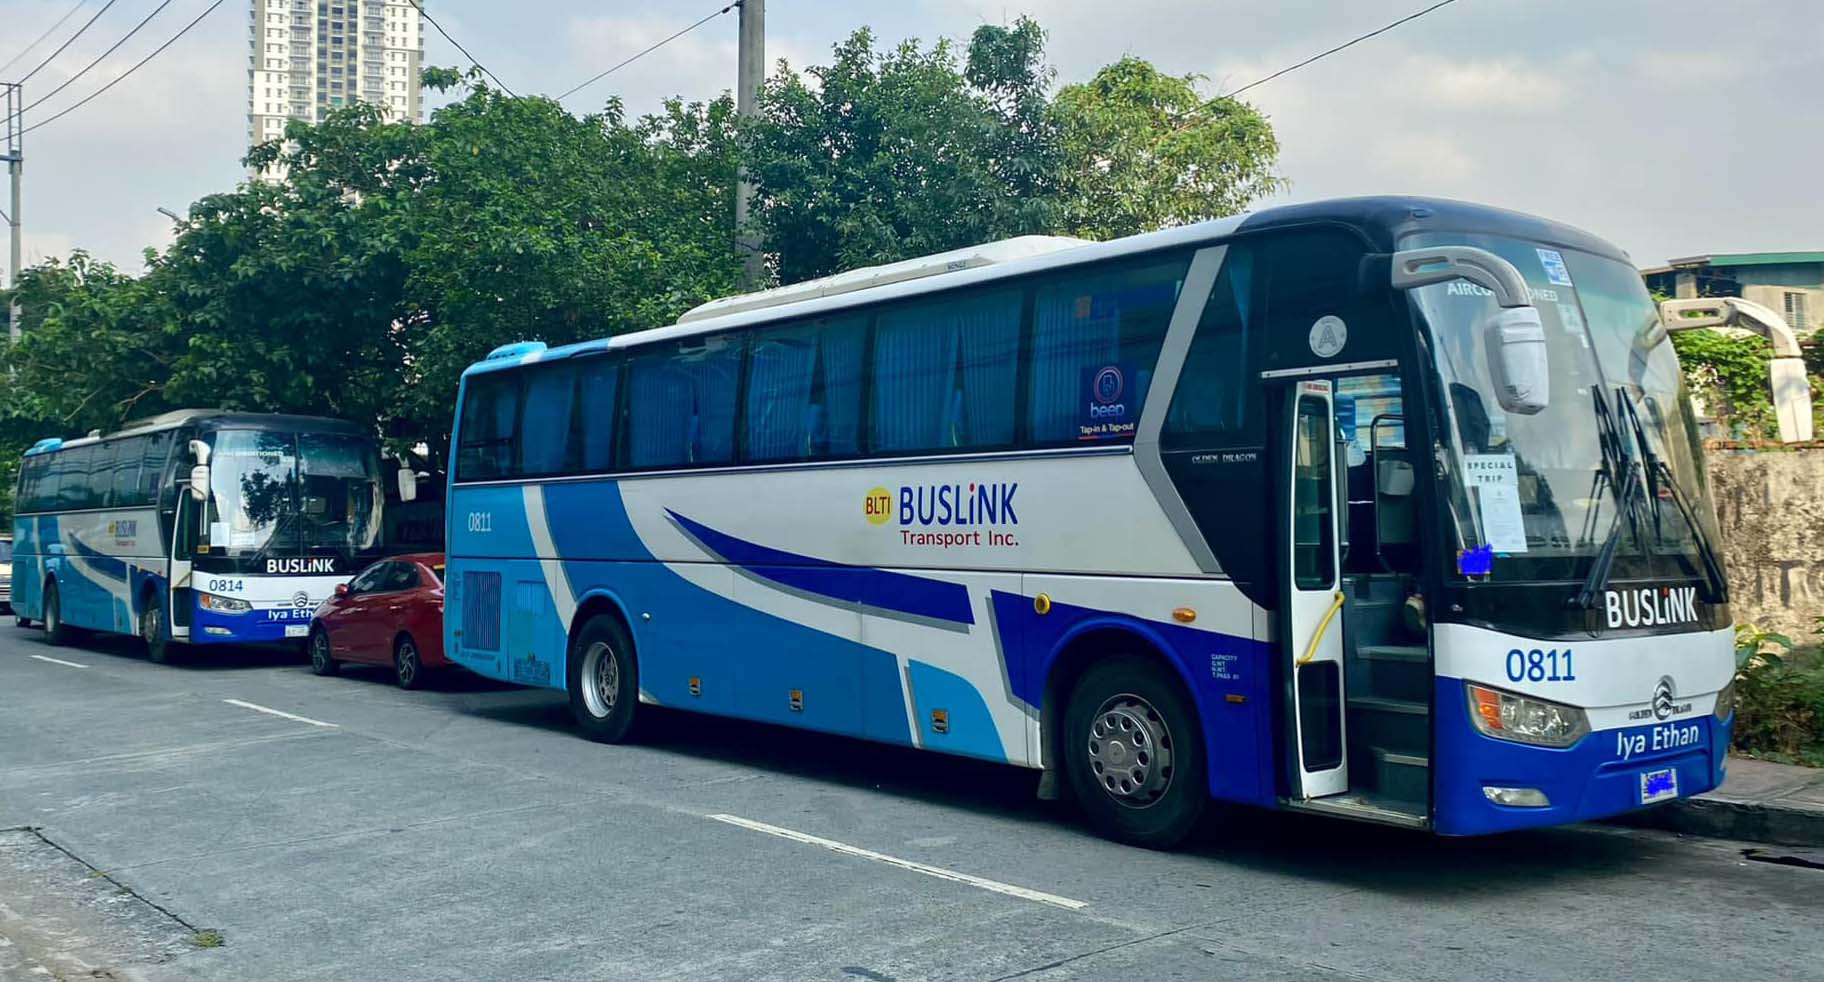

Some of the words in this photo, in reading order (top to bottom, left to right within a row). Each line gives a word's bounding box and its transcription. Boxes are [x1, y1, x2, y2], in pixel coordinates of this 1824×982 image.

[1090, 402, 1125, 418] beep
[1222, 453, 1257, 462] DRAGON
[1467, 462, 1513, 470] SPECIAL
[1477, 475, 1503, 483] TRIP
[866, 496, 891, 515] BLTI
[468, 511, 492, 532] 0811
[900, 530, 980, 549] Transport
[988, 530, 1019, 546] Inc.
[209, 579, 243, 592] 0814
[268, 610, 288, 621] Iya
[292, 609, 313, 619] Eth
[1506, 648, 1576, 682] 0811
[1616, 731, 1646, 761] Iya
[1652, 723, 1699, 750] Ethan
